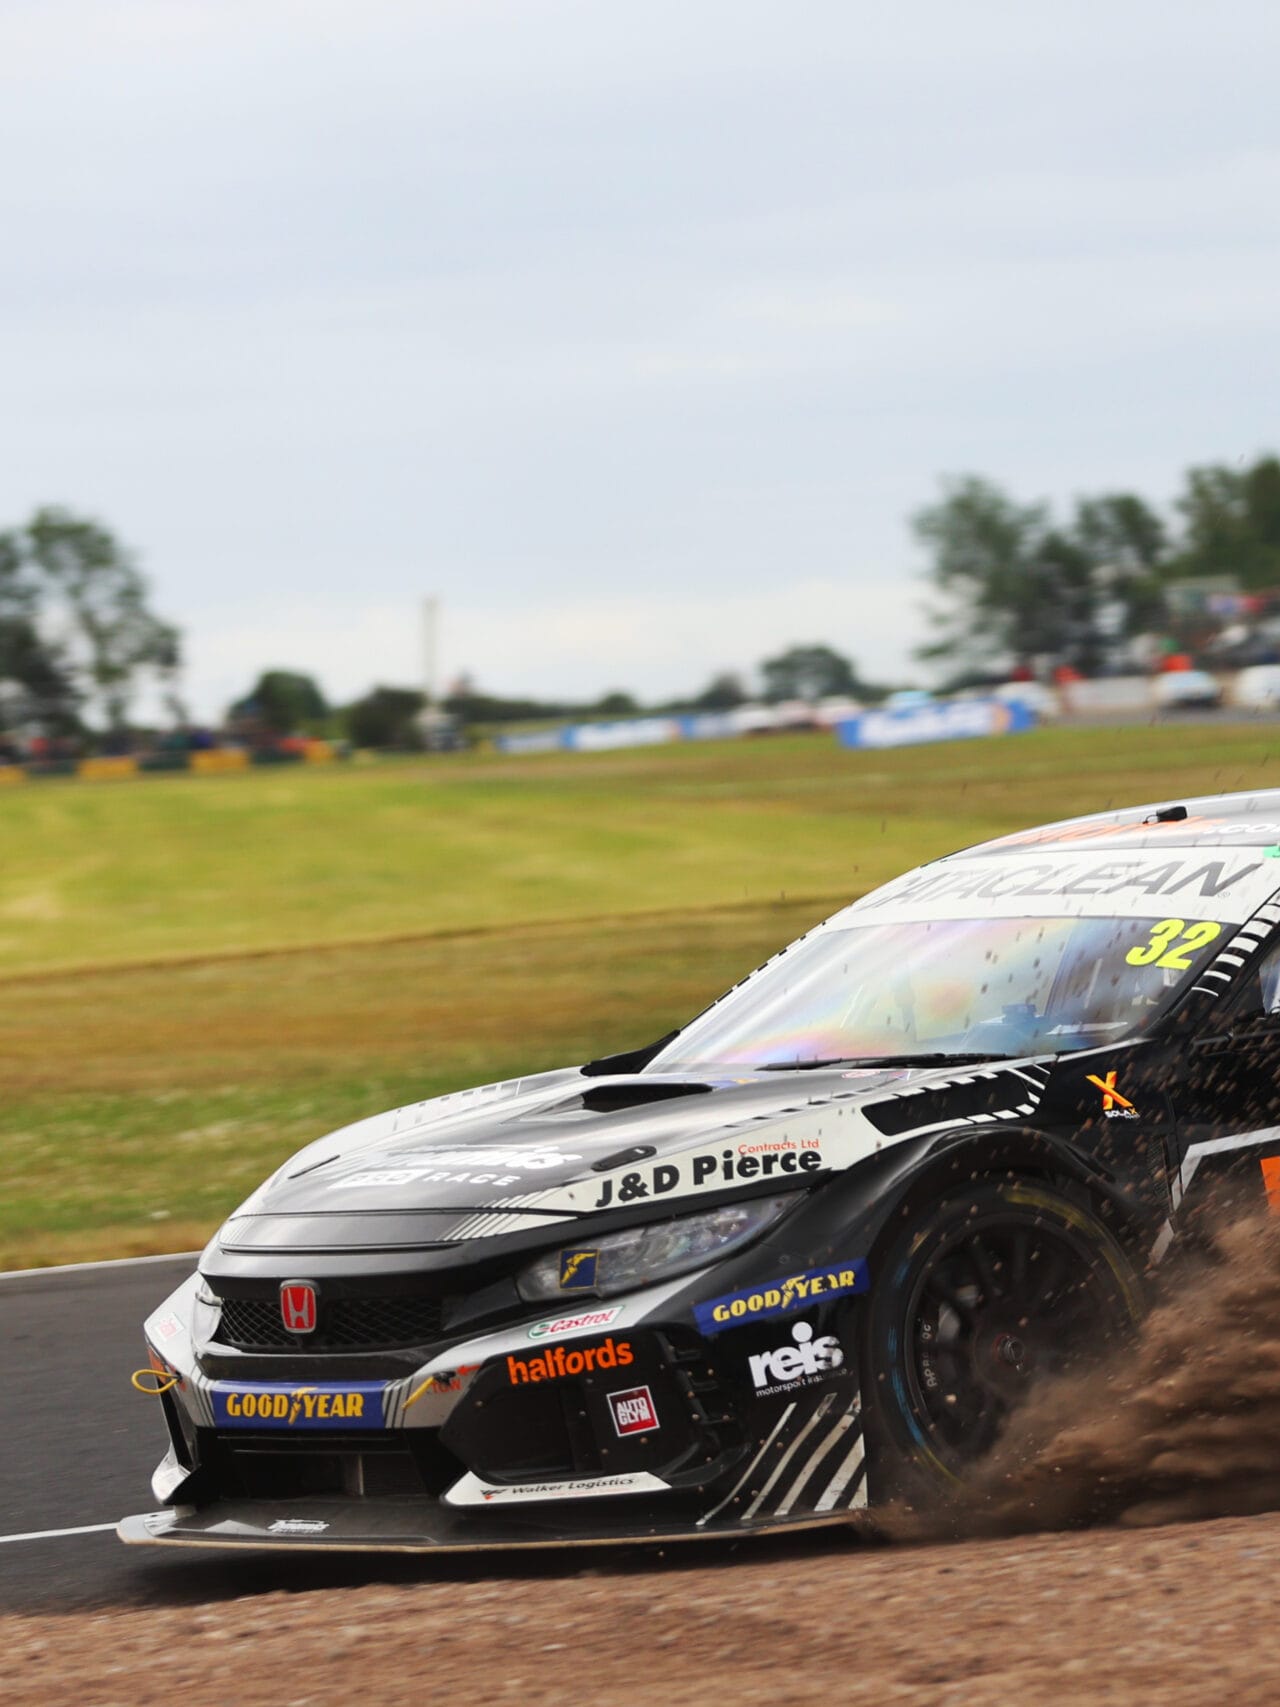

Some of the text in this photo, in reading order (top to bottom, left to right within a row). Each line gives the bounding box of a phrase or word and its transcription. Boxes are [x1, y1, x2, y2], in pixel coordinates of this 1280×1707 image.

[886, 857, 1264, 901] ATACLEAN
[1125, 918, 1221, 970] 32
[738, 1138, 819, 1156] Contracts Ltd
[424, 1172, 520, 1186] RACE
[595, 1149, 822, 1208] J&D Pierce
[550, 1309, 616, 1333] Castrol
[507, 1338, 634, 1385] halfords
[748, 1321, 844, 1388] reis
[226, 1387, 364, 1424] GOODYEAR
[617, 1396, 647, 1412] AUTO
[619, 1407, 651, 1426] GLYM
[512, 1484, 563, 1494] Walker
[569, 1477, 634, 1489] Logistics
